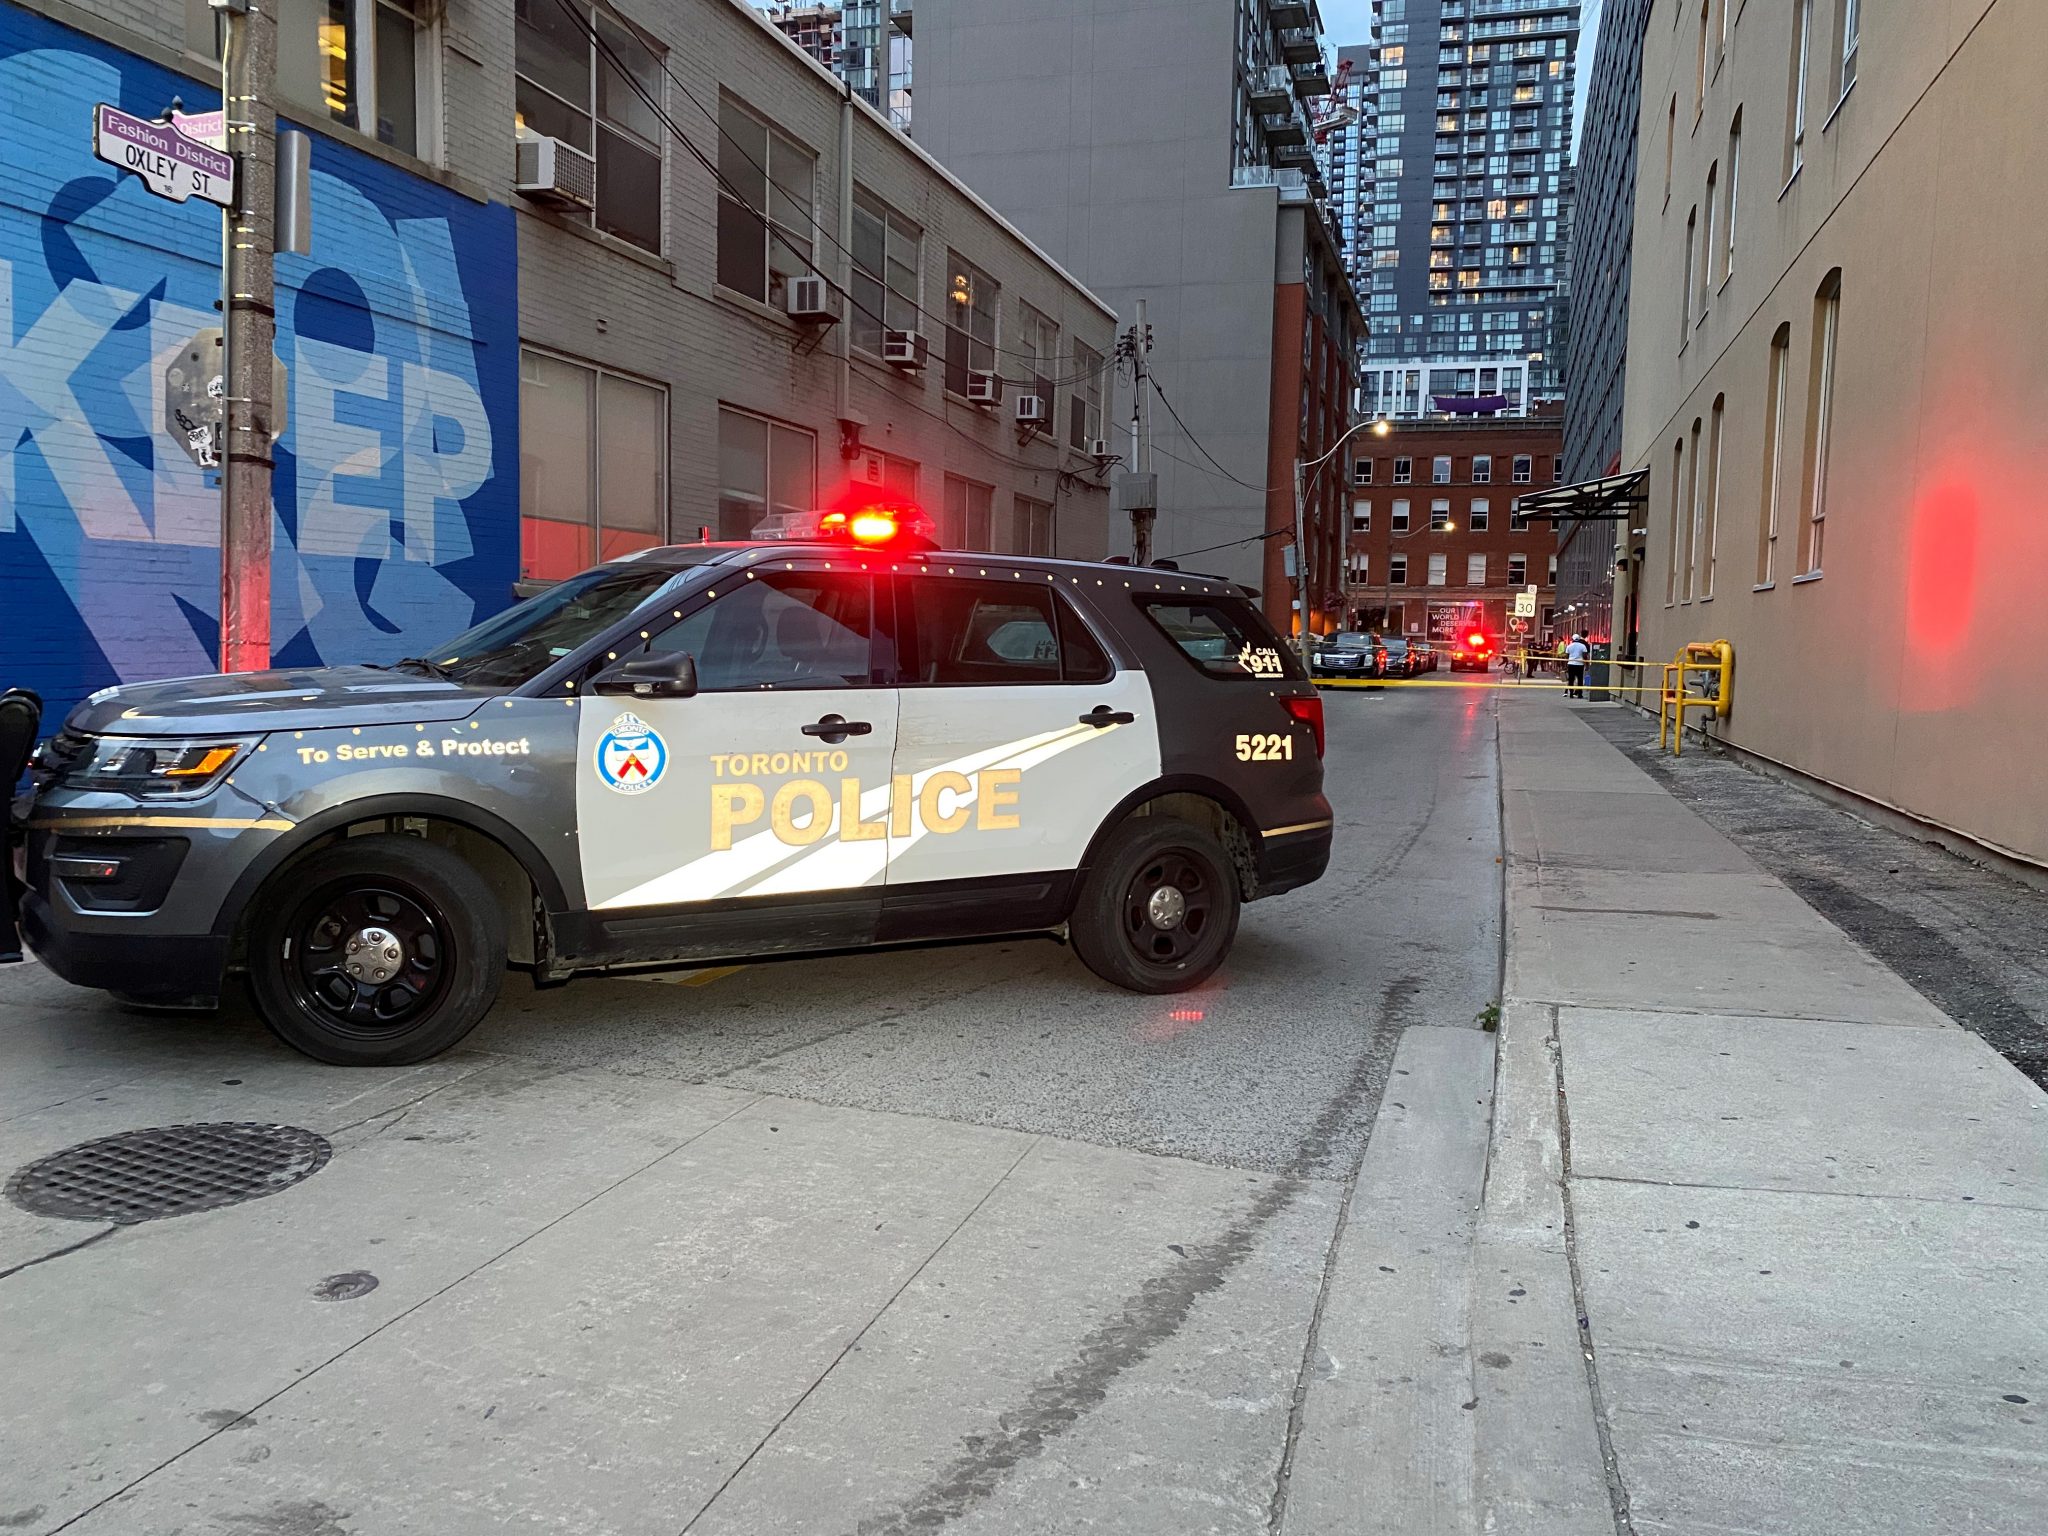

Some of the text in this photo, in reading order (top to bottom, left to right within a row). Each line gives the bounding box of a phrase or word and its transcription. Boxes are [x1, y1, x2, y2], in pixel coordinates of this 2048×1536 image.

[107, 114, 227, 175] Fashion District
[126, 144, 212, 196] OXLEY ST.
[1517, 603, 1534, 614] 30
[1255, 647, 1279, 656] CALL
[297, 737, 530, 764] To Serve & Protect
[1235, 733, 1293, 762] 5221
[710, 750, 849, 777] TORONTO
[711, 768, 1022, 851] POLICE
